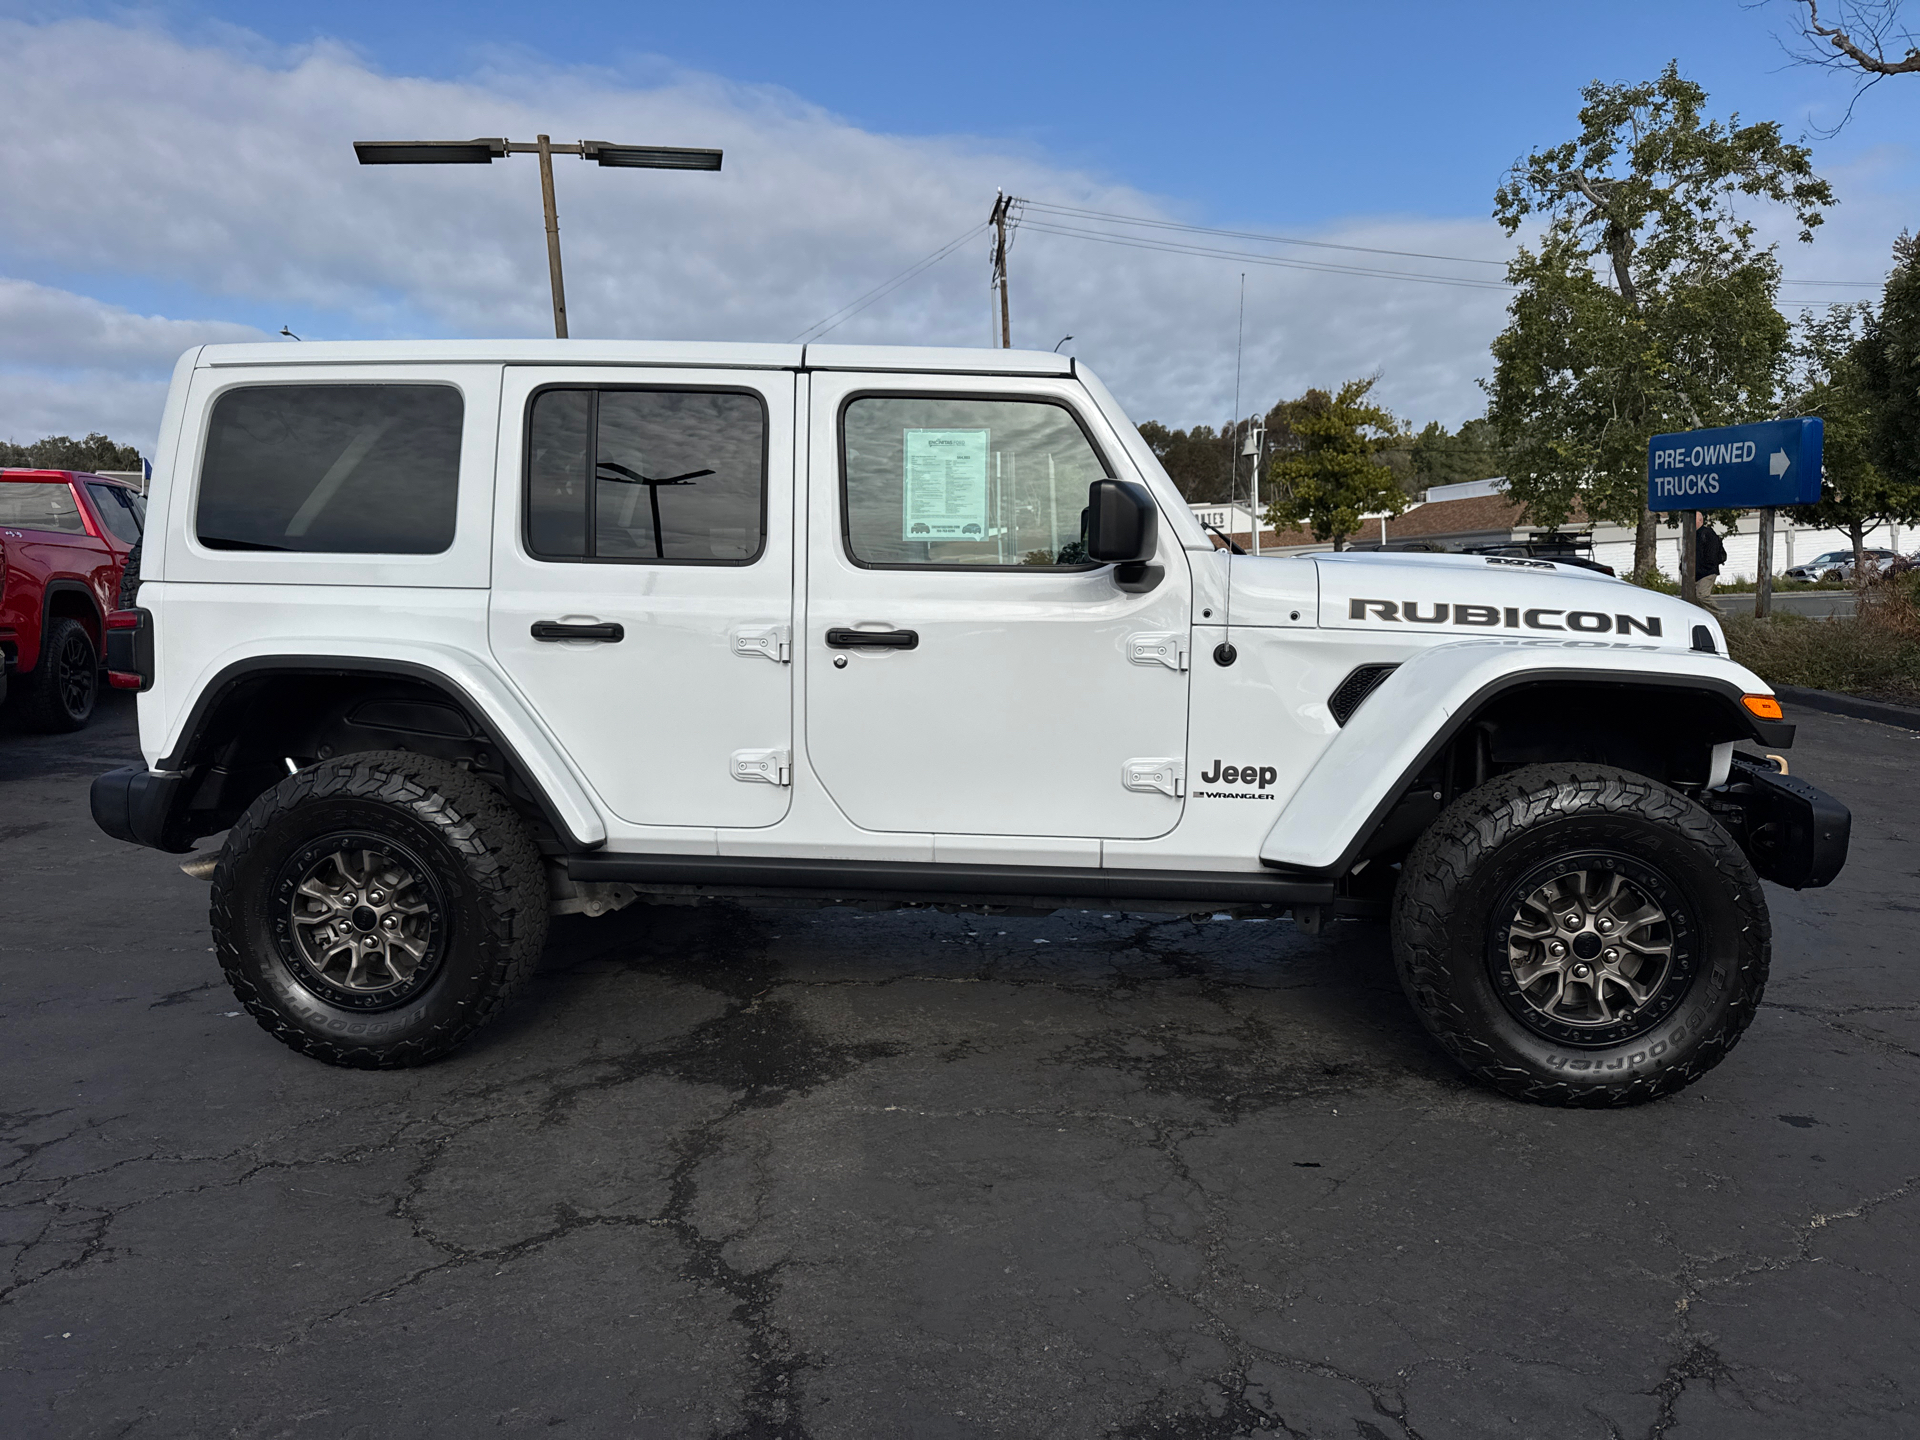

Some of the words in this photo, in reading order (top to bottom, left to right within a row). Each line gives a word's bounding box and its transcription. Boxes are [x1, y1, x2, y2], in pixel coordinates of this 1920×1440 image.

[1654, 441, 1756, 470] PRE-OWNED
[1654, 472, 1720, 497] TRUCKS
[1348, 597, 1663, 638] RUBICON
[1201, 759, 1277, 789] Jeep
[1205, 791, 1275, 800] WRANGLER
[259, 960, 428, 1038] BFGoodrich
[1546, 960, 1727, 1073] BFGoodrich
